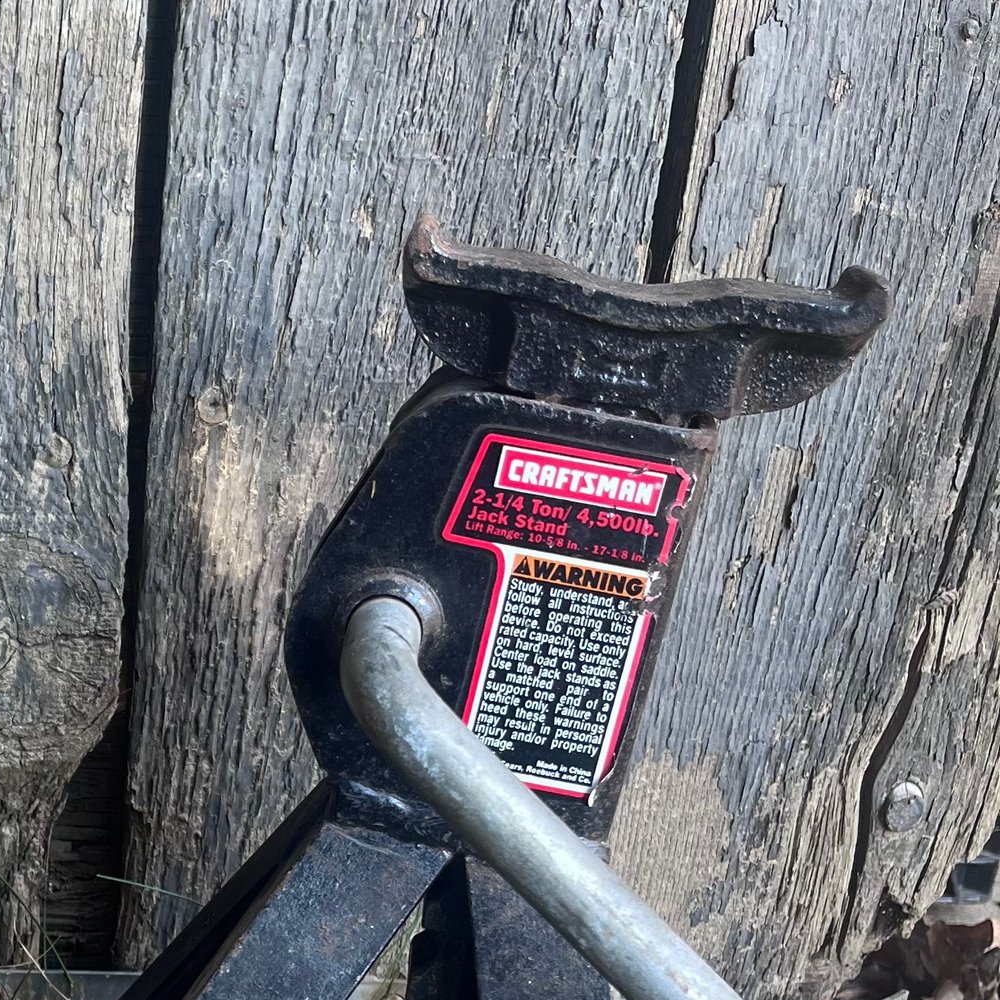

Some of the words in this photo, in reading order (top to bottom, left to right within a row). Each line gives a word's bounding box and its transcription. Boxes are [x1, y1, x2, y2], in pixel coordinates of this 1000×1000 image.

[468, 506, 507, 525] Jack
[515, 514, 567, 535] Stand
[472, 489, 523, 511] 2-1/4
[532, 499, 571, 520] Ton/
[577, 508, 658, 537] 4,500lb.
[465, 520, 483, 532] Lift
[486, 524, 523, 540] Range:
[528, 533, 564, 548] 10-5/8
[567, 540, 579, 550] in.
[592, 545, 628, 559] 17-1/8
[631, 552, 644, 562] in.
[533, 558, 644, 597] WARNING
[508, 590, 540, 605] follow
[548, 599, 561, 609] all
[570, 604, 633, 622] instructions
[550, 588, 614, 610] understand,
[502, 613, 539, 628] device.
[546, 621, 561, 633] Do
[567, 627, 585, 637] not
[590, 629, 629, 645] exceed
[505, 601, 540, 617] before
[549, 612, 602, 631] operating
[611, 622, 631, 634] this
[497, 637, 510, 646] on
[548, 645, 574, 658] level
[579, 653, 620, 667] surface.
[499, 626, 527, 638] rated
[529, 631, 574, 650] capacity.
[579, 639, 599, 652] Use
[601, 645, 625, 659] only
[491, 657, 511, 670] Use
[517, 662, 533, 674] the
[537, 666, 560, 681] jack
[566, 673, 600, 687] stands
[603, 681, 615, 689] as
[494, 646, 528, 661] Center
[534, 654, 557, 667] load
[562, 661, 575, 670] on
[581, 665, 617, 678] saddle.
[486, 681, 529, 696] support
[534, 690, 554, 701] one
[560, 694, 581, 706] end
[586, 700, 598, 709] of
[602, 703, 609, 711] a
[488, 670, 495, 678] a
[506, 673, 553, 689] matched
[566, 685, 588, 699] pair
[603, 690, 613, 701] to
[480, 701, 507, 714] heed
[516, 708, 545, 723] these
[554, 717, 604, 737] warnings
[484, 692, 519, 705] vehicle
[525, 700, 548, 714] only.
[555, 704, 590, 720] Failure
[596, 712, 606, 722] to
[475, 722, 506, 739] injury
[511, 731, 546, 744] and/or
[551, 737, 598, 756] property
[477, 713, 500, 726] may
[505, 719, 535, 732] result
[540, 724, 550, 734] in
[555, 726, 602, 747] personal
[526, 766, 559, 777] Roebuck
[536, 760, 557, 770] Made
[569, 767, 591, 776] China
